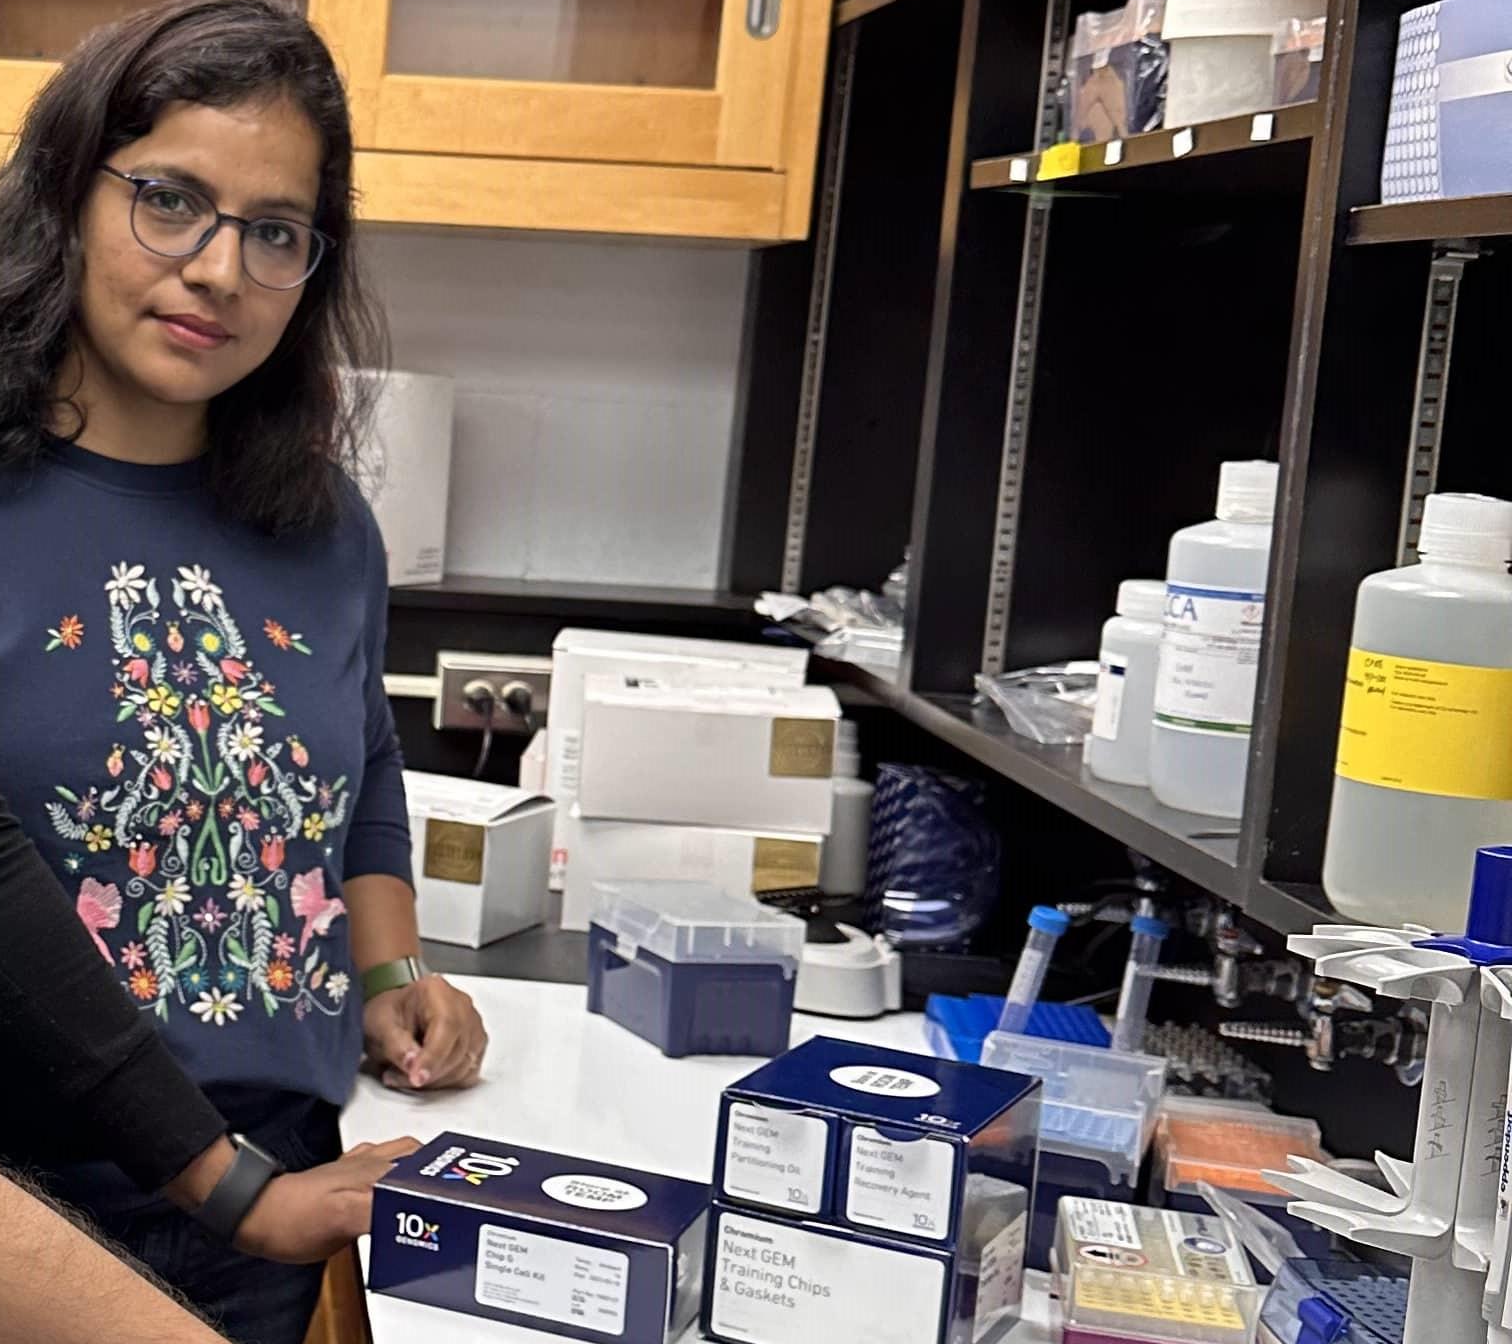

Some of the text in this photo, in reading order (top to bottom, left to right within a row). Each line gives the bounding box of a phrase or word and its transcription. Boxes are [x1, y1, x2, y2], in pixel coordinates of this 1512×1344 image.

[1164, 594, 1198, 622] CA
[734, 1122, 779, 1137] Next GEM
[733, 1136, 770, 1154] Training
[856, 1145, 904, 1162] Next GEM
[441, 1152, 520, 1185] 10x
[731, 1152, 785, 1173] Partitioning
[855, 1161, 895, 1179] Training
[854, 1177, 930, 1200] Recovery Agent
[396, 1212, 440, 1242] 10x
[723, 1225, 774, 1244] Chromium
[396, 1235, 440, 1252] GENOMICS
[508, 1243, 529, 1254] GEM
[485, 1250, 505, 1262] Chip
[723, 1239, 796, 1269] Next GEM
[484, 1260, 513, 1274] Single
[722, 1258, 831, 1298] Training Chips
[720, 1277, 796, 1308] & Gaskets
